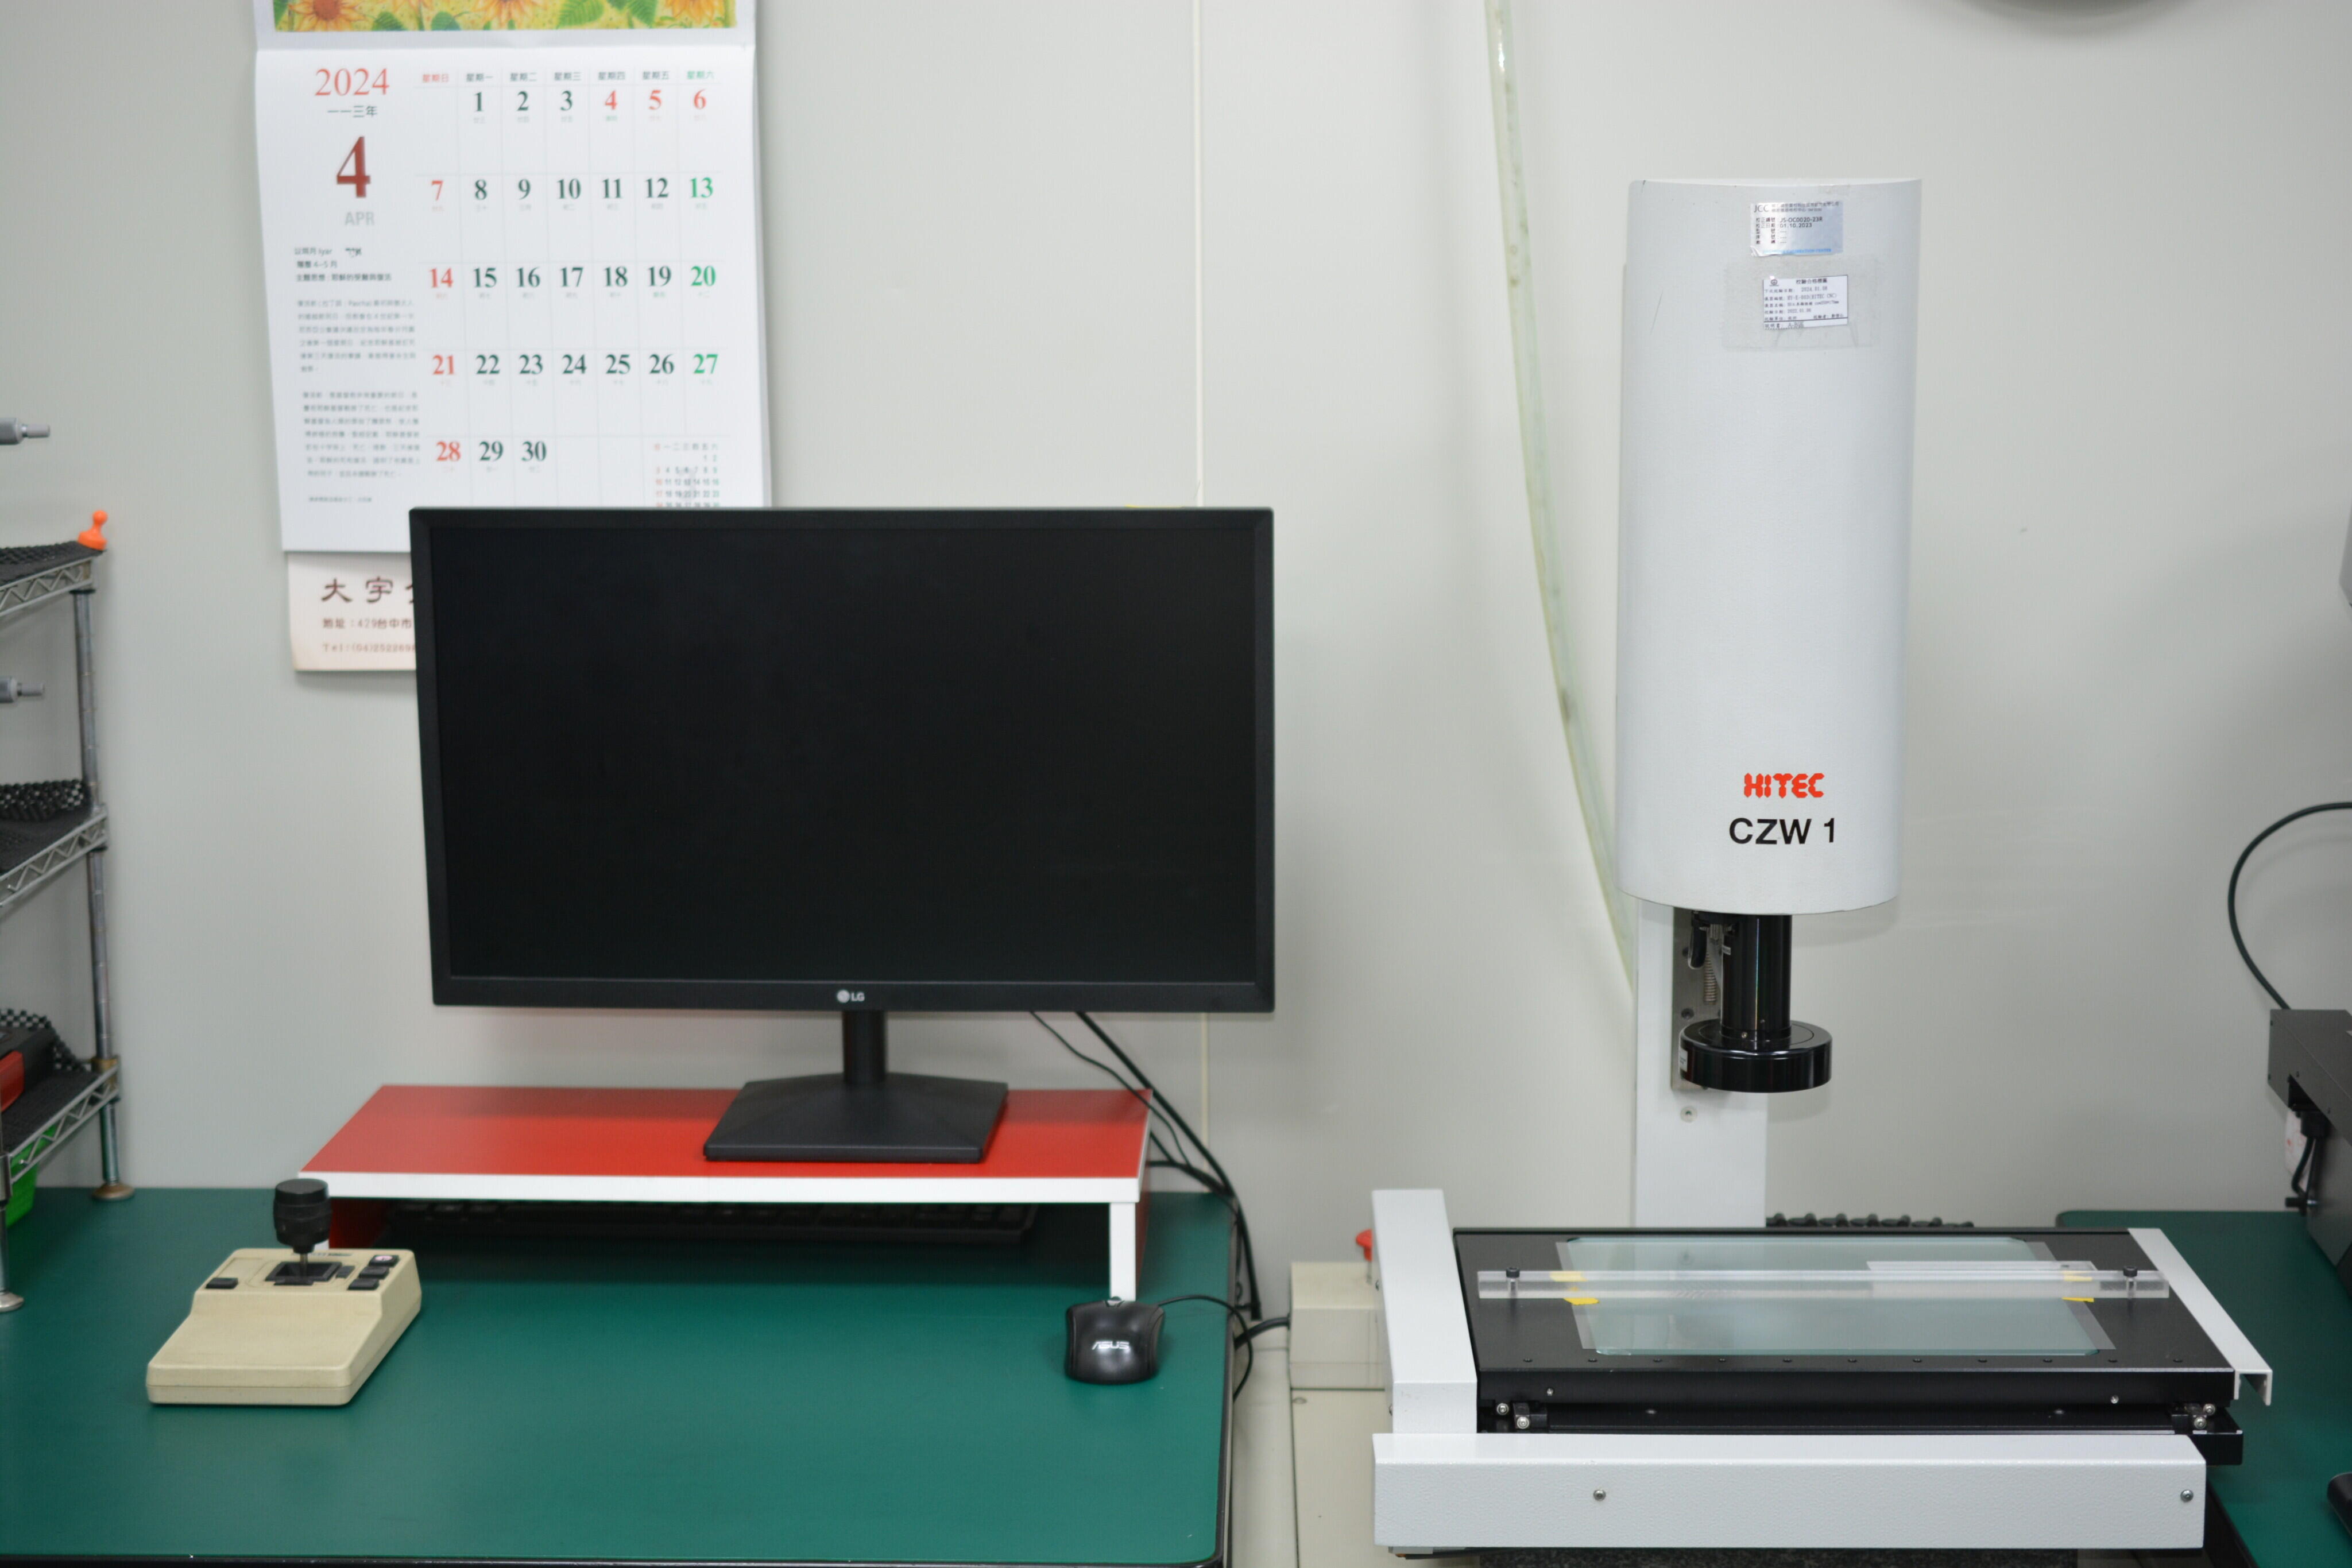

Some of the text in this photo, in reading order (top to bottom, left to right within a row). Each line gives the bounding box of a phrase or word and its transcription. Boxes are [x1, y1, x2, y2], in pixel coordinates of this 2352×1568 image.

[315, 68, 390, 96] 2024
[421, 70, 714, 83] 星期日 星期一 星期二 星期三 星期四 星期五 星期六
[327, 104, 377, 118] 一一三年
[474, 89, 707, 112] 1 2 3 4 5 6
[336, 136, 370, 198] 4
[431, 176, 714, 200] 7 8 9 10 11 12 13
[345, 211, 374, 226] APR
[1754, 204, 1769, 212] JCC
[431, 265, 717, 288] 14 15 16 17 18 19 20
[432, 354, 454, 375] 21
[476, 354, 500, 375] 22
[519, 354, 543, 375] 23
[563, 354, 587, 374] 24
[606, 354, 630, 374] 25
[649, 353, 675, 374] 26
[694, 353, 718, 374] 27
[436, 440, 547, 462] 28 29 30
[321, 576, 413, 604] 大宇
[1743, 773, 1825, 798] HITEC
[1729, 817, 1835, 845] CZW 1
[851, 992, 865, 1001] LG
[1092, 1341, 1131, 1350] ASUS
